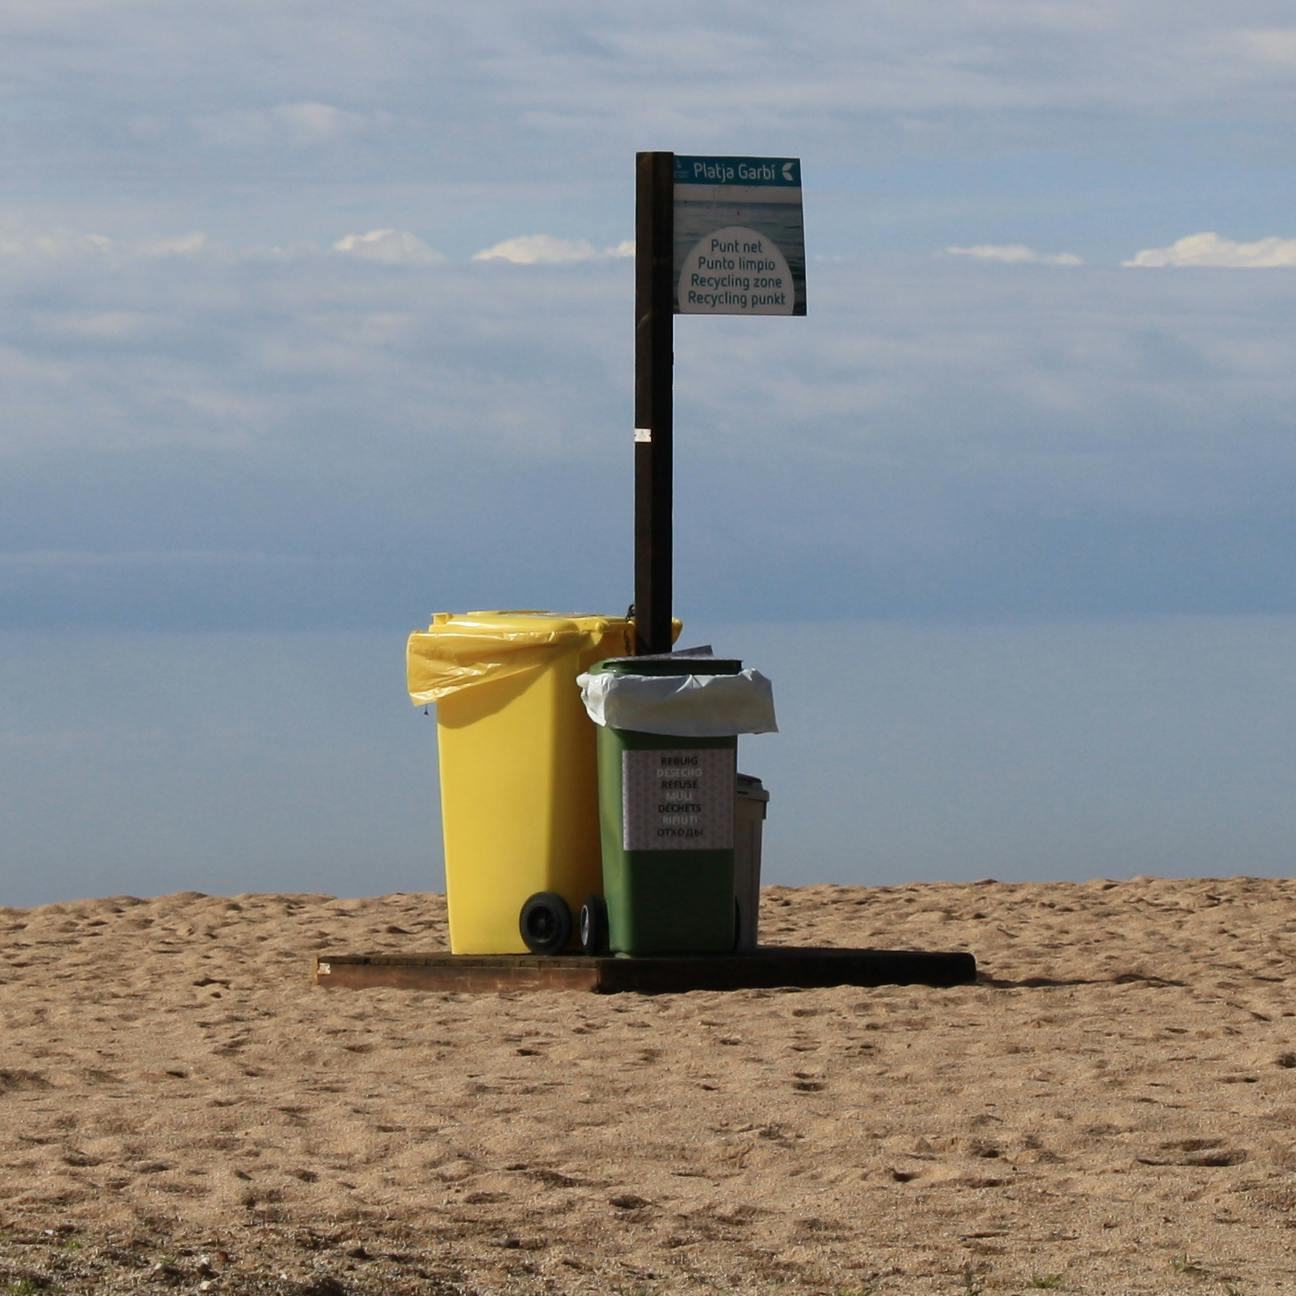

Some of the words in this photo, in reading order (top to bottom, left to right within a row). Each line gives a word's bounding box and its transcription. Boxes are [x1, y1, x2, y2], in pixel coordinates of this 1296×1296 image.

[694, 162, 734, 182] Platja
[711, 239, 739, 253] Punt
[743, 241, 763, 254] net
[698, 256, 735, 270] Punto
[739, 257, 776, 273] limpio
[691, 273, 750, 291] Recycling
[754, 277, 782, 288] zone
[688, 290, 747, 308] Recycling
[751, 293, 786, 308] punkt
[661, 756, 698, 766] REBUIG
[661, 780, 698, 789] REFUSE
[657, 828, 704, 839] ОТХОДЫ
